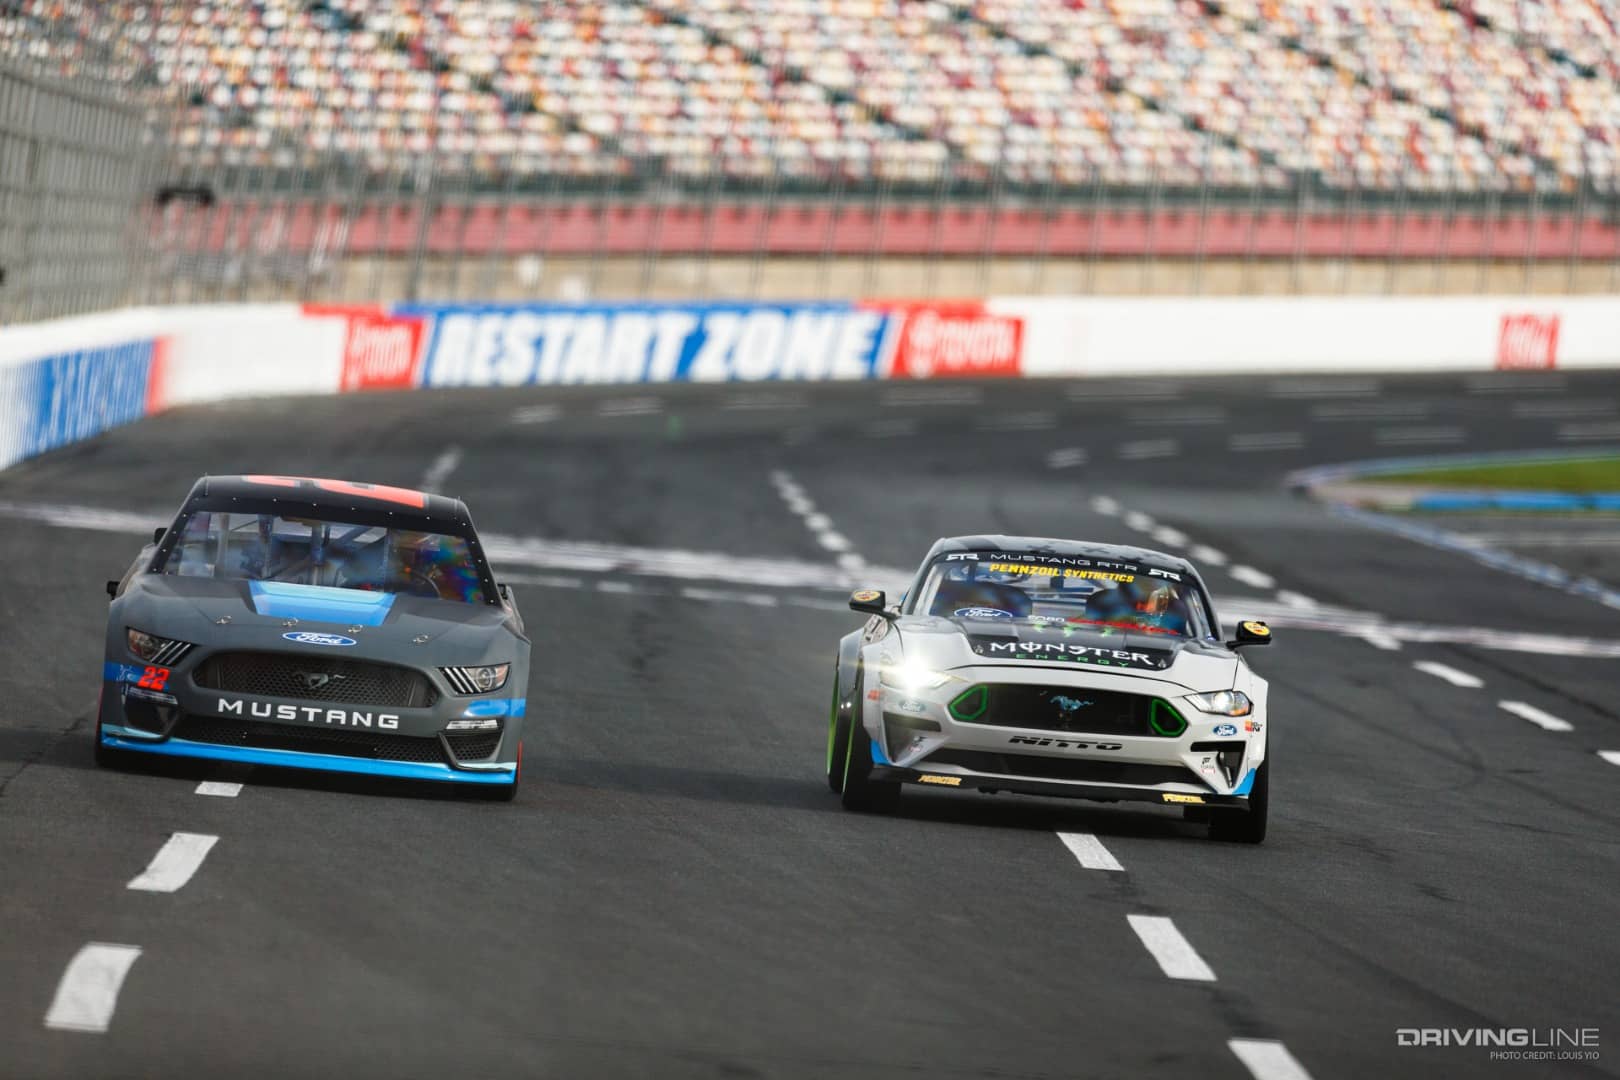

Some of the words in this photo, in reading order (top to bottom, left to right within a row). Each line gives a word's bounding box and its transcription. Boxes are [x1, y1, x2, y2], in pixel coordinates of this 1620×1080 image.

[430, 311, 697, 387] RESTART
[690, 311, 879, 382] ZONE
[990, 554, 1091, 567] MUSTANG
[1097, 561, 1137, 571] RTR
[989, 563, 1060, 577] PENNZOIL
[1063, 568, 1135, 583] SYNTHETICS
[295, 631, 343, 645] Ford
[990, 641, 1155, 666] MONSTER
[1016, 653, 1129, 668] ENERGY
[137, 665, 171, 691] 22
[217, 698, 400, 730] MUSTANG
[1008, 735, 1123, 751] NITTO
